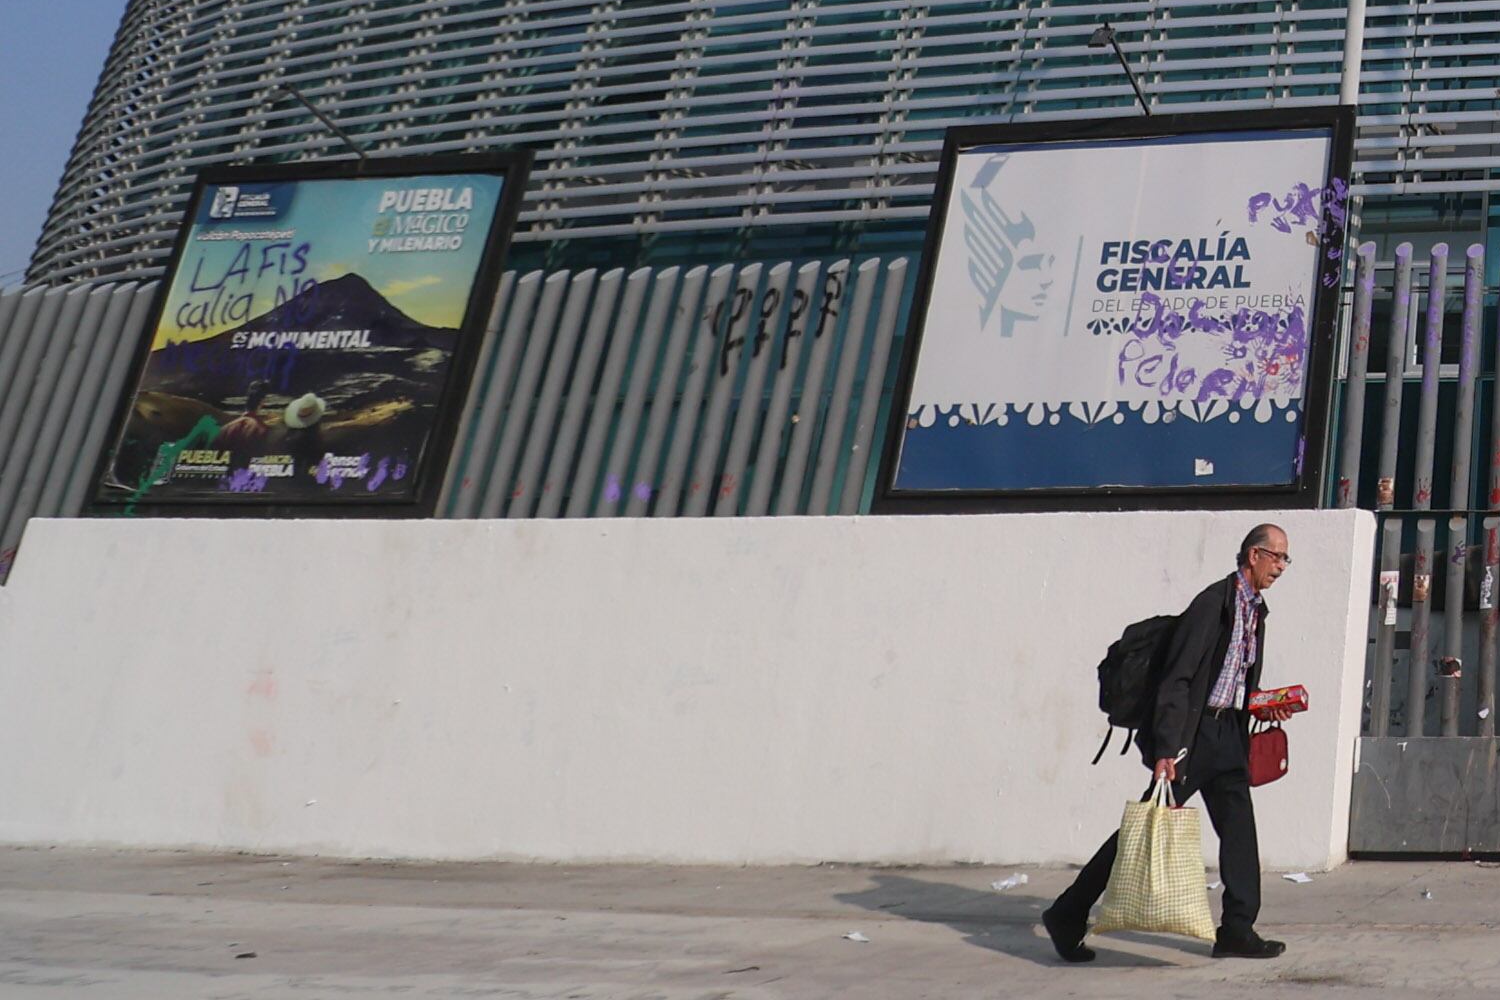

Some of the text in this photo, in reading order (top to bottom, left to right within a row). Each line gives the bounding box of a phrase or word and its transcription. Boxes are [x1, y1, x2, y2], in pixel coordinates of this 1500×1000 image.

[378, 187, 473, 214] PUEBLA
[380, 235, 463, 253] MILENARIO
[1100, 231, 1252, 265] FISCALÍA
[1096, 264, 1252, 293] GENERAL
[1092, 293, 1306, 313] DEL ESADO DE PUEBLA
[178, 449, 232, 465] PUEBLA
